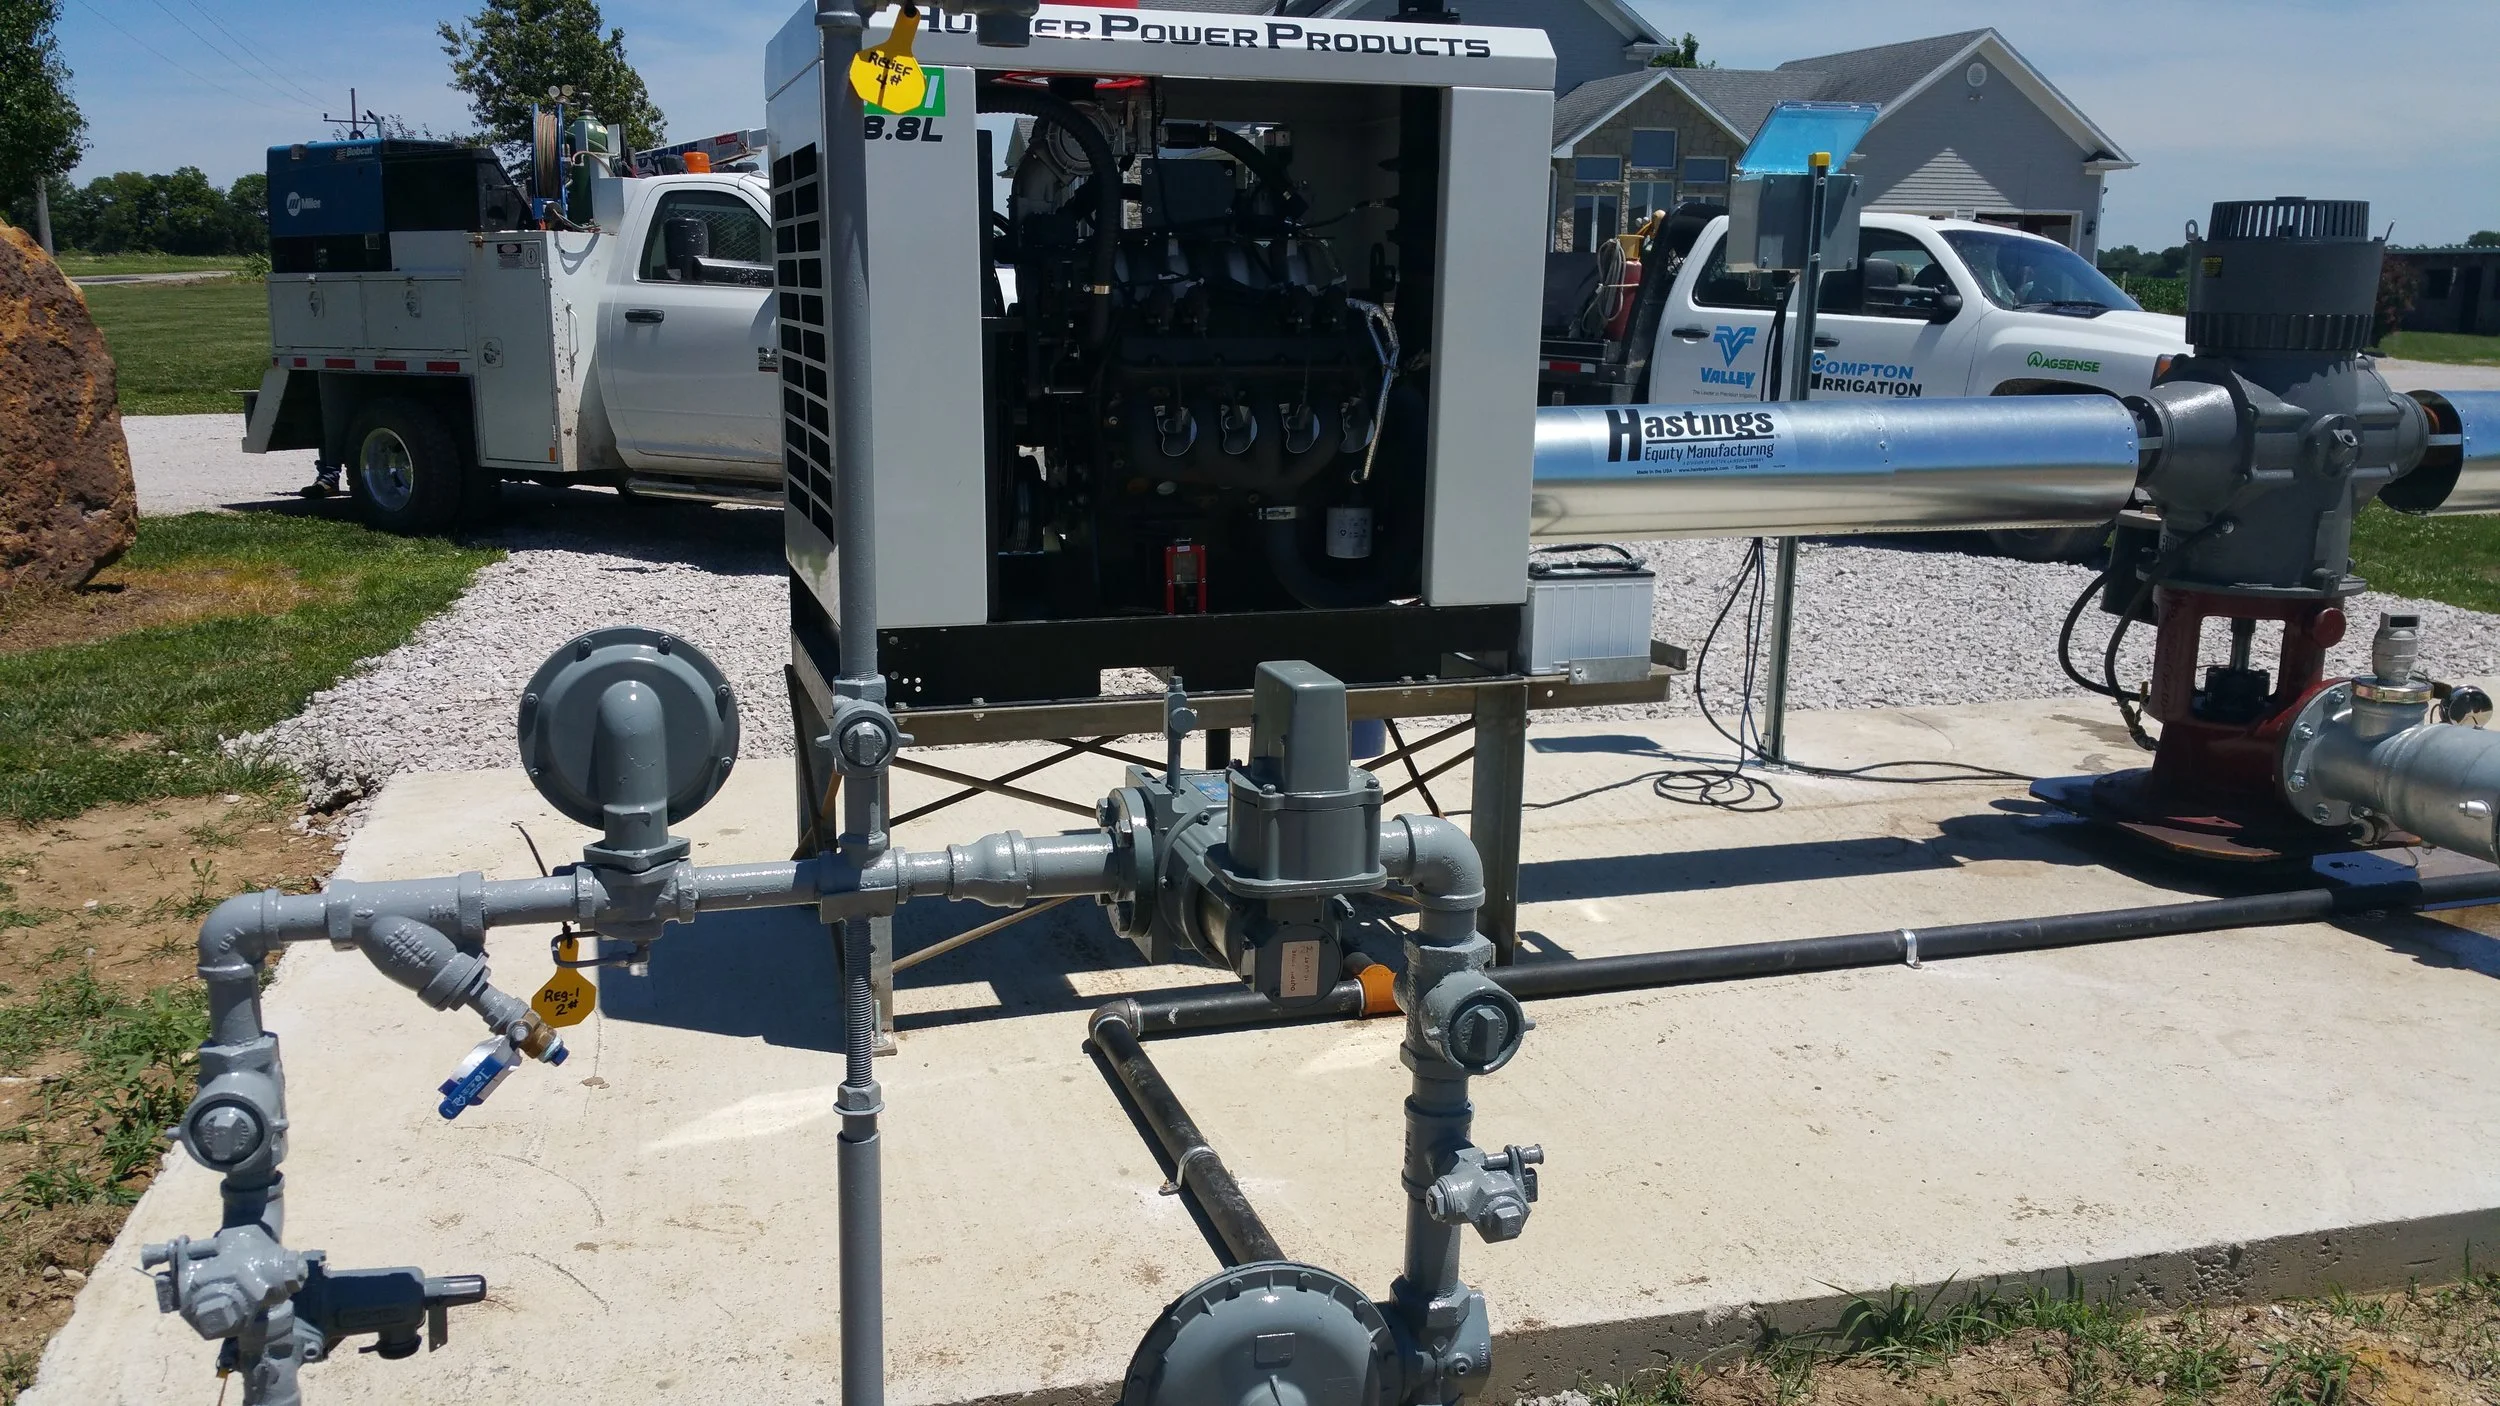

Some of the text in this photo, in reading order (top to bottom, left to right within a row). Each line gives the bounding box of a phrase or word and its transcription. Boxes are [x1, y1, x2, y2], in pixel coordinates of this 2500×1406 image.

[918, 7, 1490, 58] HUER POWER PRODUCTS
[346, 146, 373, 156] Bobcat
[301, 198, 321, 209] Miller
[1811, 353, 1914, 380] COMPTON
[1701, 367, 1755, 389] VALLEY
[1605, 409, 1774, 462] Hastings
[1645, 443, 1774, 463] Equity Manufacturing
